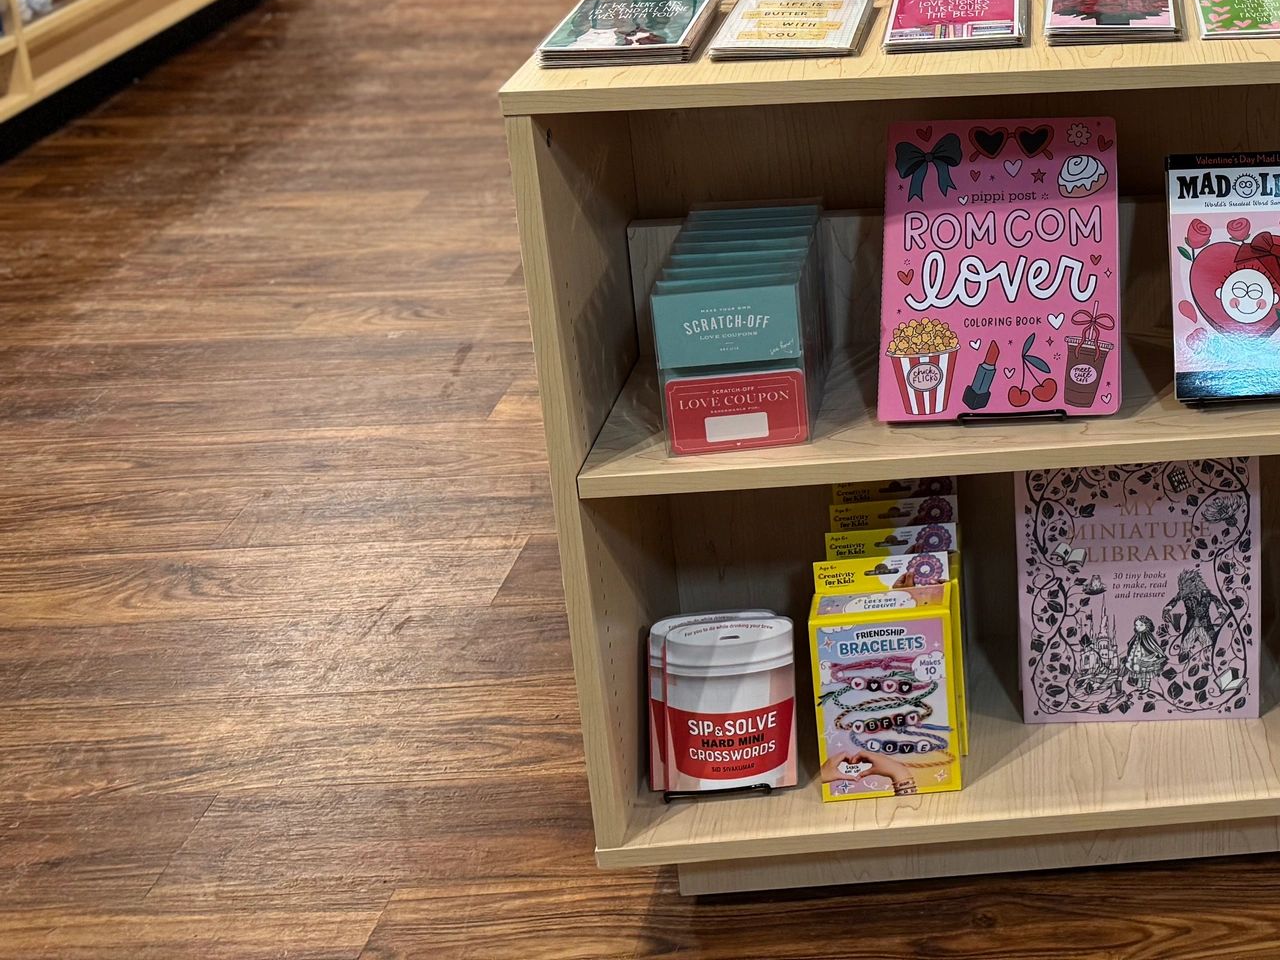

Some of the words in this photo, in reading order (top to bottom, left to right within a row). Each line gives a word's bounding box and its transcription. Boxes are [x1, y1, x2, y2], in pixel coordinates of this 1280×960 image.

[919, 0, 944, 8] LOVE
[952, 10, 985, 18] BEST!
[1195, 155, 1238, 165] Valentine's
[1240, 155, 1256, 165] Day
[1256, 154, 1275, 162] Mad
[1177, 171, 1232, 200] MAD
[971, 192, 1005, 204] pippi
[1008, 191, 1037, 203] post
[904, 210, 997, 252] ROM
[1003, 205, 1103, 248] COM
[905, 250, 1097, 311] lover
[683, 314, 770, 336] SCRATCH-OFF
[963, 317, 1012, 328] COLORING
[1015, 315, 1043, 326] BOOK
[912, 372, 938, 384] FLICKS
[711, 386, 754, 395] SCRATCH-OFF
[679, 396, 721, 411] LOVE
[723, 390, 790, 407] COUPON
[1118, 501, 1156, 517] MY
[1066, 520, 1212, 541] MINIATURE
[1086, 543, 1193, 563] LIBRARY
[817, 571, 855, 581] Creativity
[824, 578, 836, 587] for
[836, 577, 855, 586] Kids
[1113, 572, 1124, 581] 30
[1126, 571, 1142, 583] tiny
[1143, 570, 1167, 579] books
[1112, 581, 1121, 590] to
[1123, 581, 1147, 591] make,
[1149, 580, 1168, 589] read
[1114, 590, 1130, 599] and
[1132, 590, 1166, 599] treasure
[855, 628, 905, 641] FRIENDSHIP
[838, 636, 925, 656] BRACELETS
[919, 659, 942, 668] Makes
[924, 666, 937, 676] 10
[687, 719, 714, 736] SIP
[724, 711, 777, 736] SOLVE
[701, 739, 735, 748] HARD
[738, 732, 765, 746] MINI
[689, 739, 776, 762] CROSSWORDS
